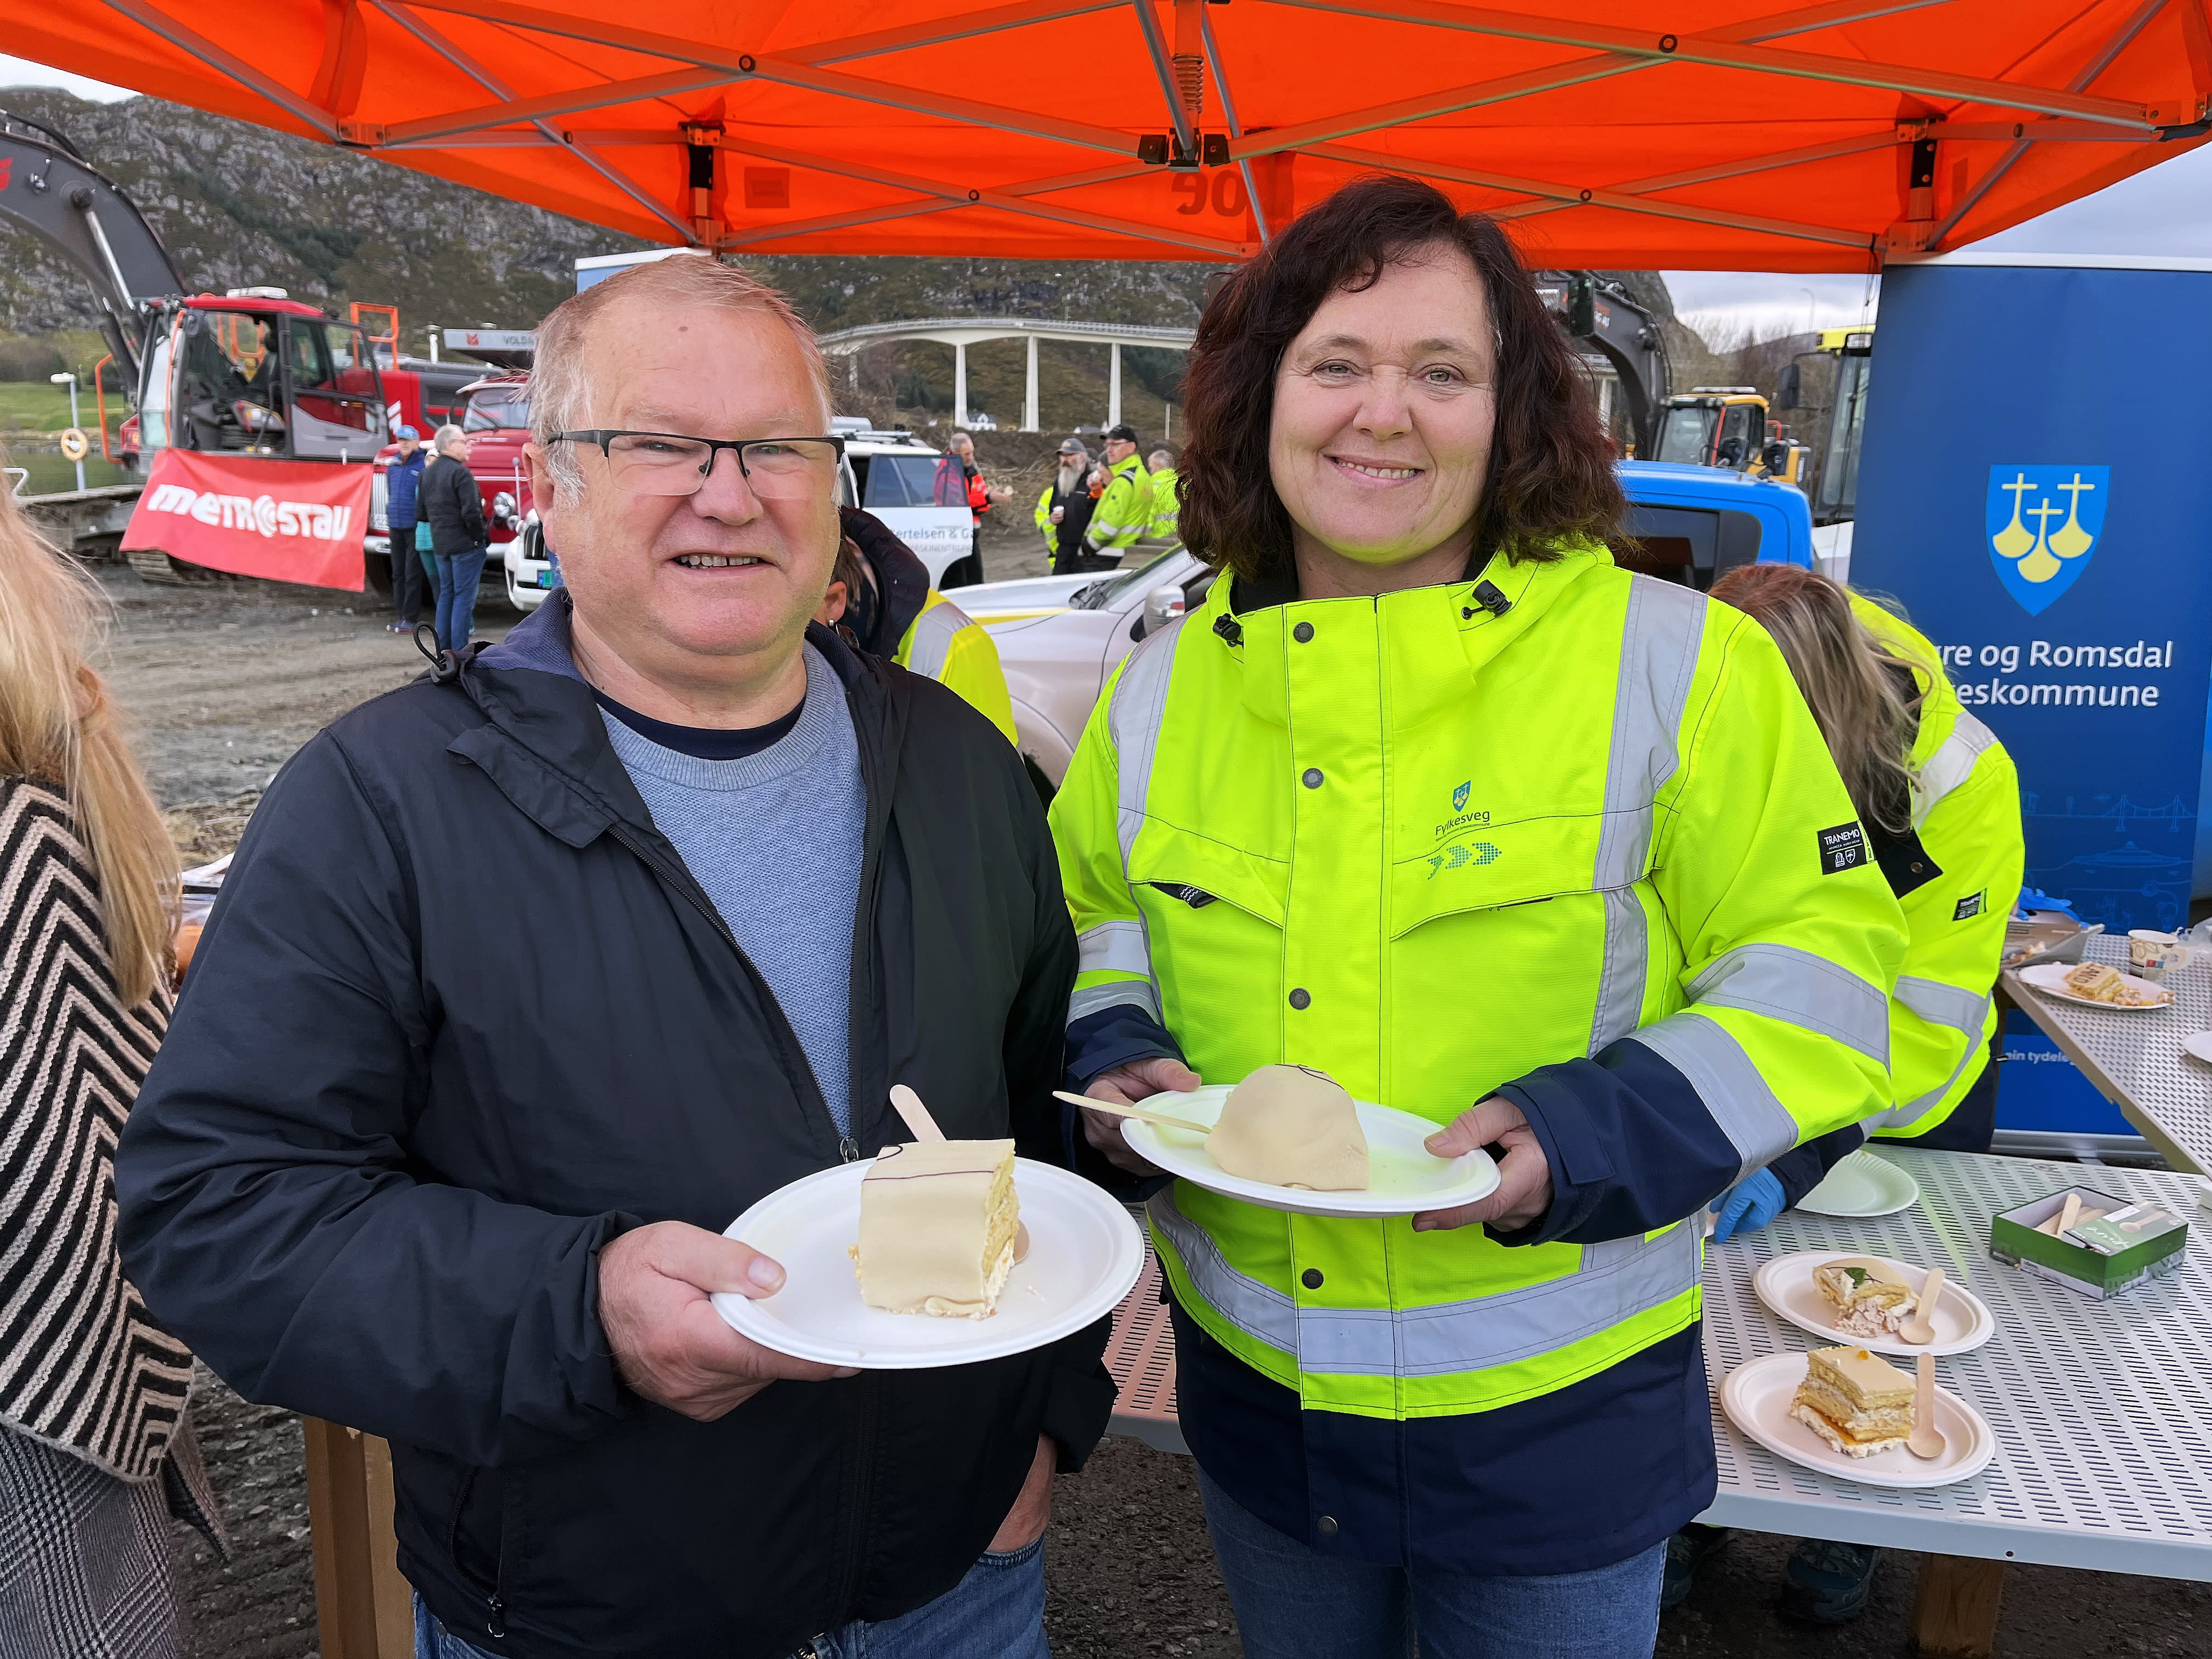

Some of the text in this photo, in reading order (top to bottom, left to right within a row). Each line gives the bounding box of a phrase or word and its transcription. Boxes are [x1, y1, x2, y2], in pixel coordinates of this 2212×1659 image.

[1979, 644, 2021, 674] og
[2029, 640, 2174, 668] Romsdal
[1951, 678, 2159, 707] eskommune
[1435, 811, 1490, 836] Fylkesveg
[1824, 828, 1860, 845] TRANEMO
[2028, 1051, 2076, 1065] tydele
